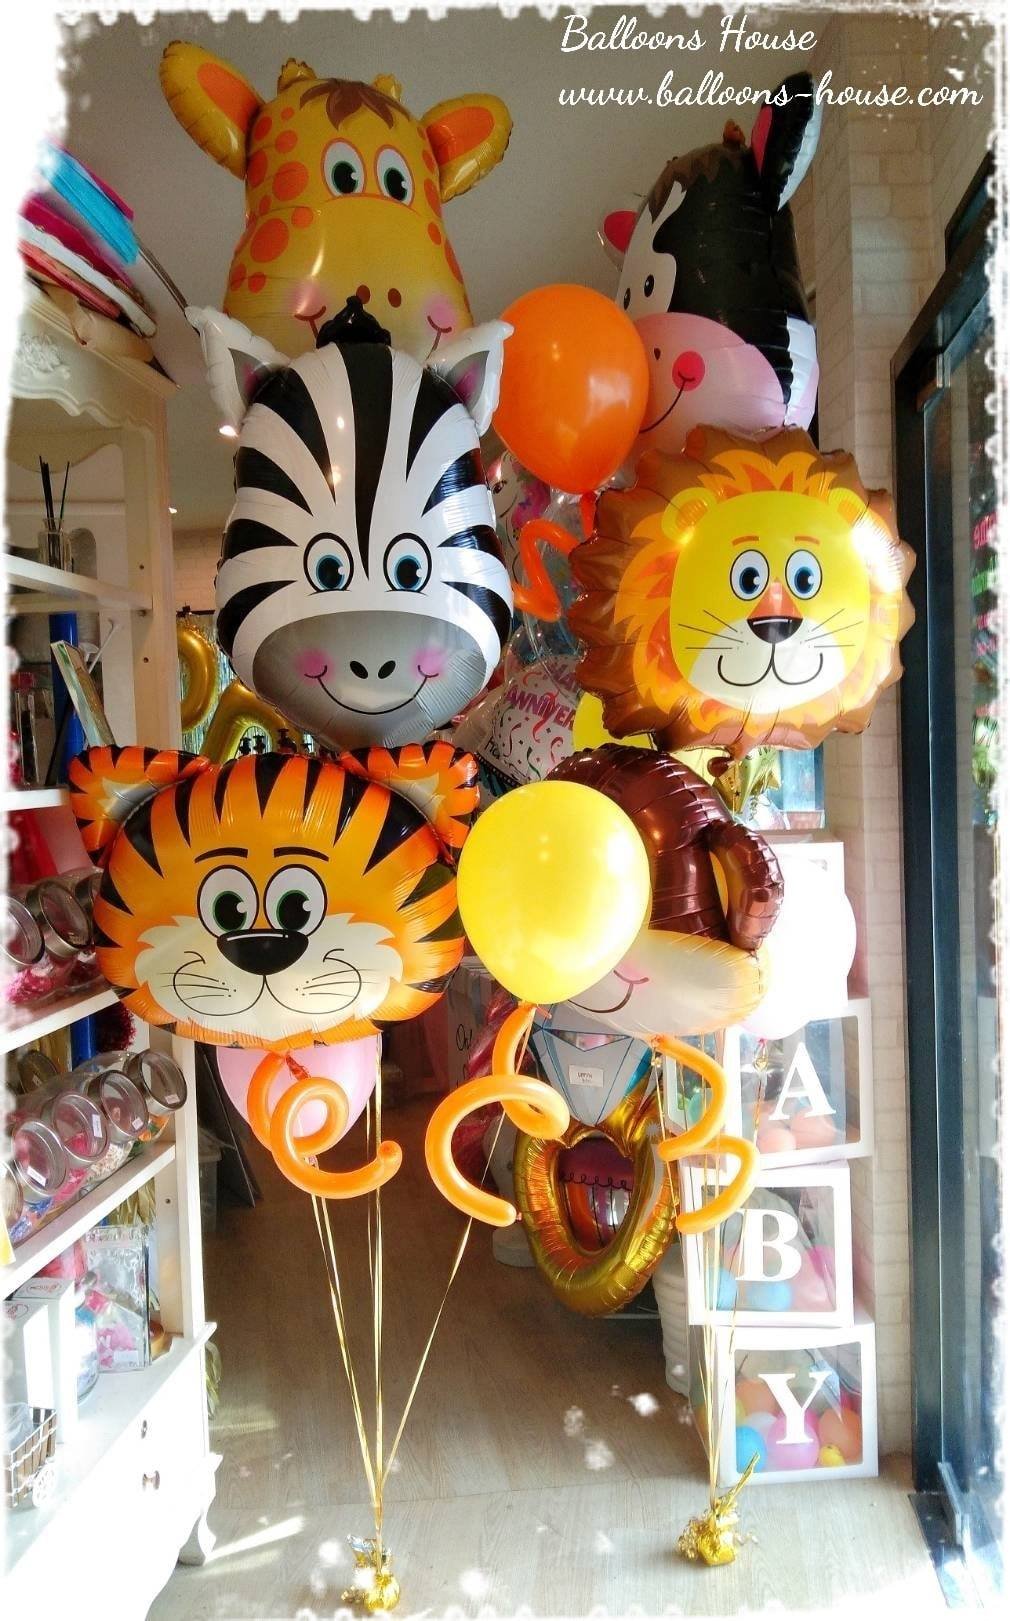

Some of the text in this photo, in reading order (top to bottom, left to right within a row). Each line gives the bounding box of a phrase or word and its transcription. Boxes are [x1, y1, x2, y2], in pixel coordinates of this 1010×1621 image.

[768, 1041, 836, 1121] A
[735, 1207, 802, 1283] B
[758, 1371, 833, 1445] Y
